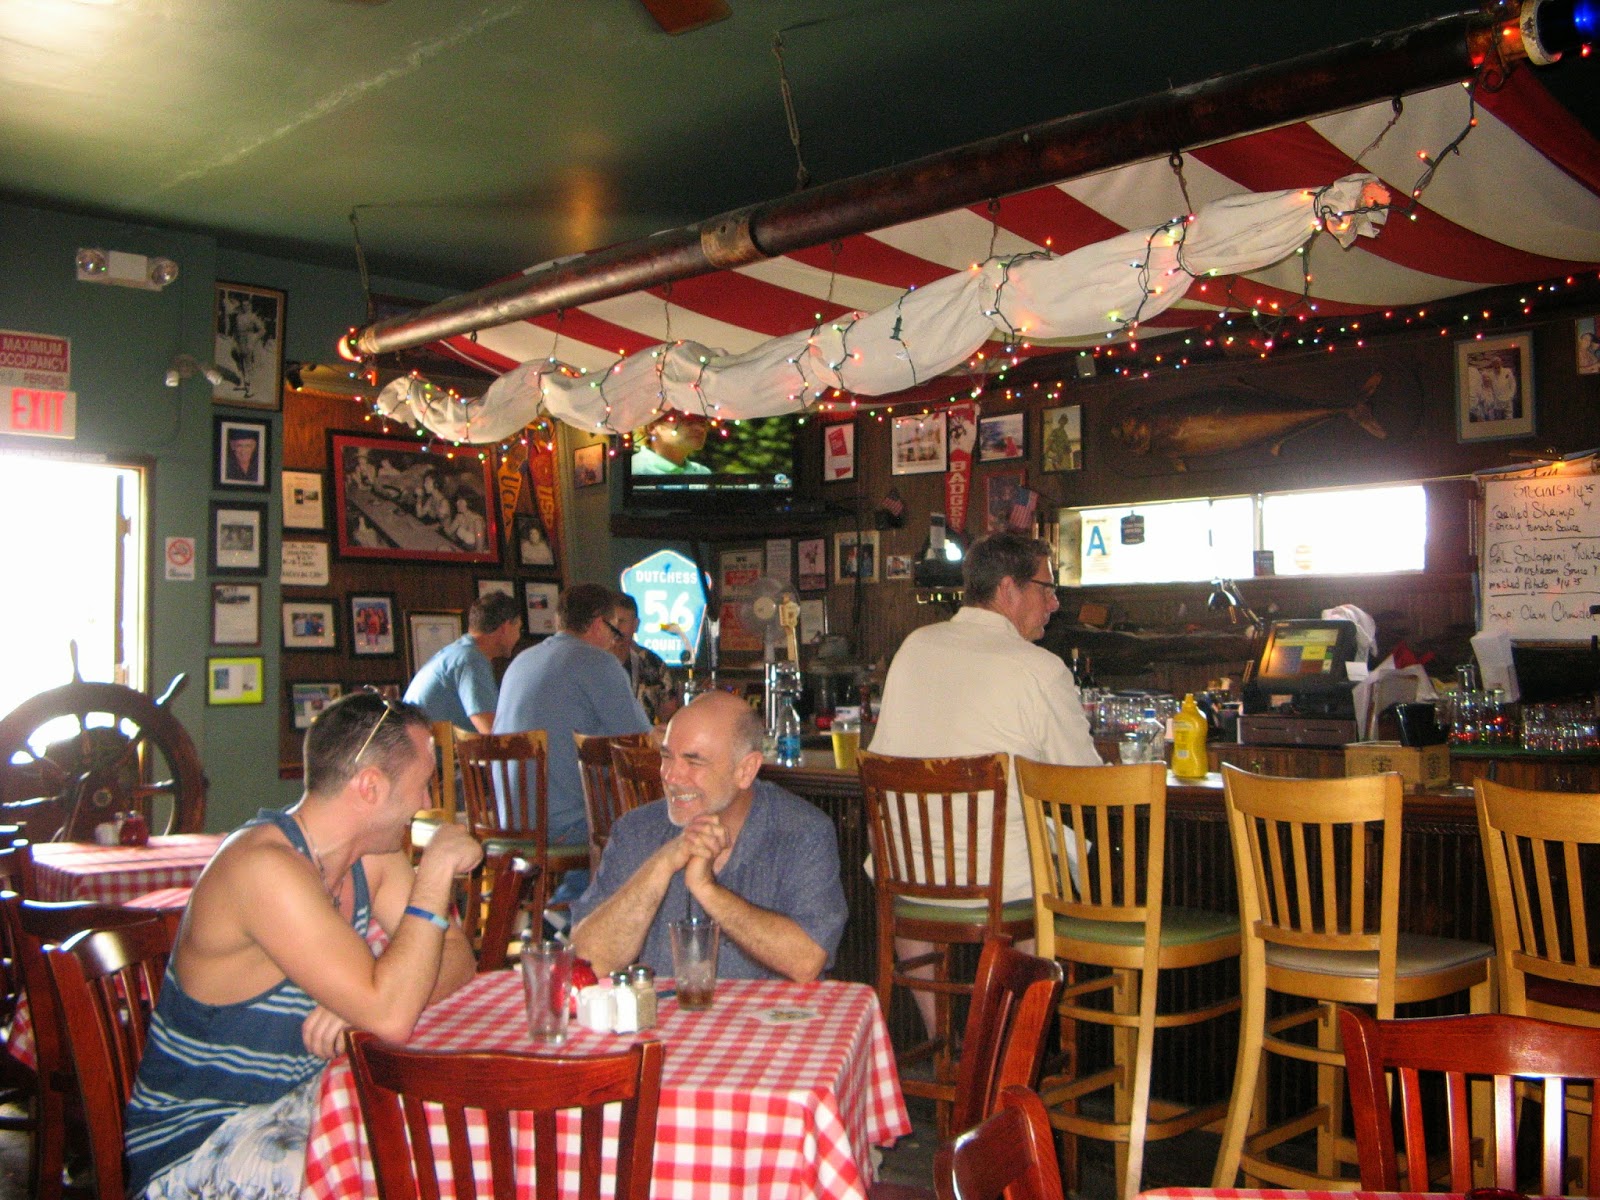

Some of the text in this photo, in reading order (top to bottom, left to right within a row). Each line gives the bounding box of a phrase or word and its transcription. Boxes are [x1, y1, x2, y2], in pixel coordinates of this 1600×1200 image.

[3, 338, 63, 356] MAXIMUM
[0, 352, 67, 371] OCCUPANCY
[11, 387, 66, 433] EXIT
[1086, 525, 1107, 556] A
[635, 570, 698, 585] DUTCHESS
[643, 589, 695, 634] 56
[644, 638, 681, 651] COUNT
